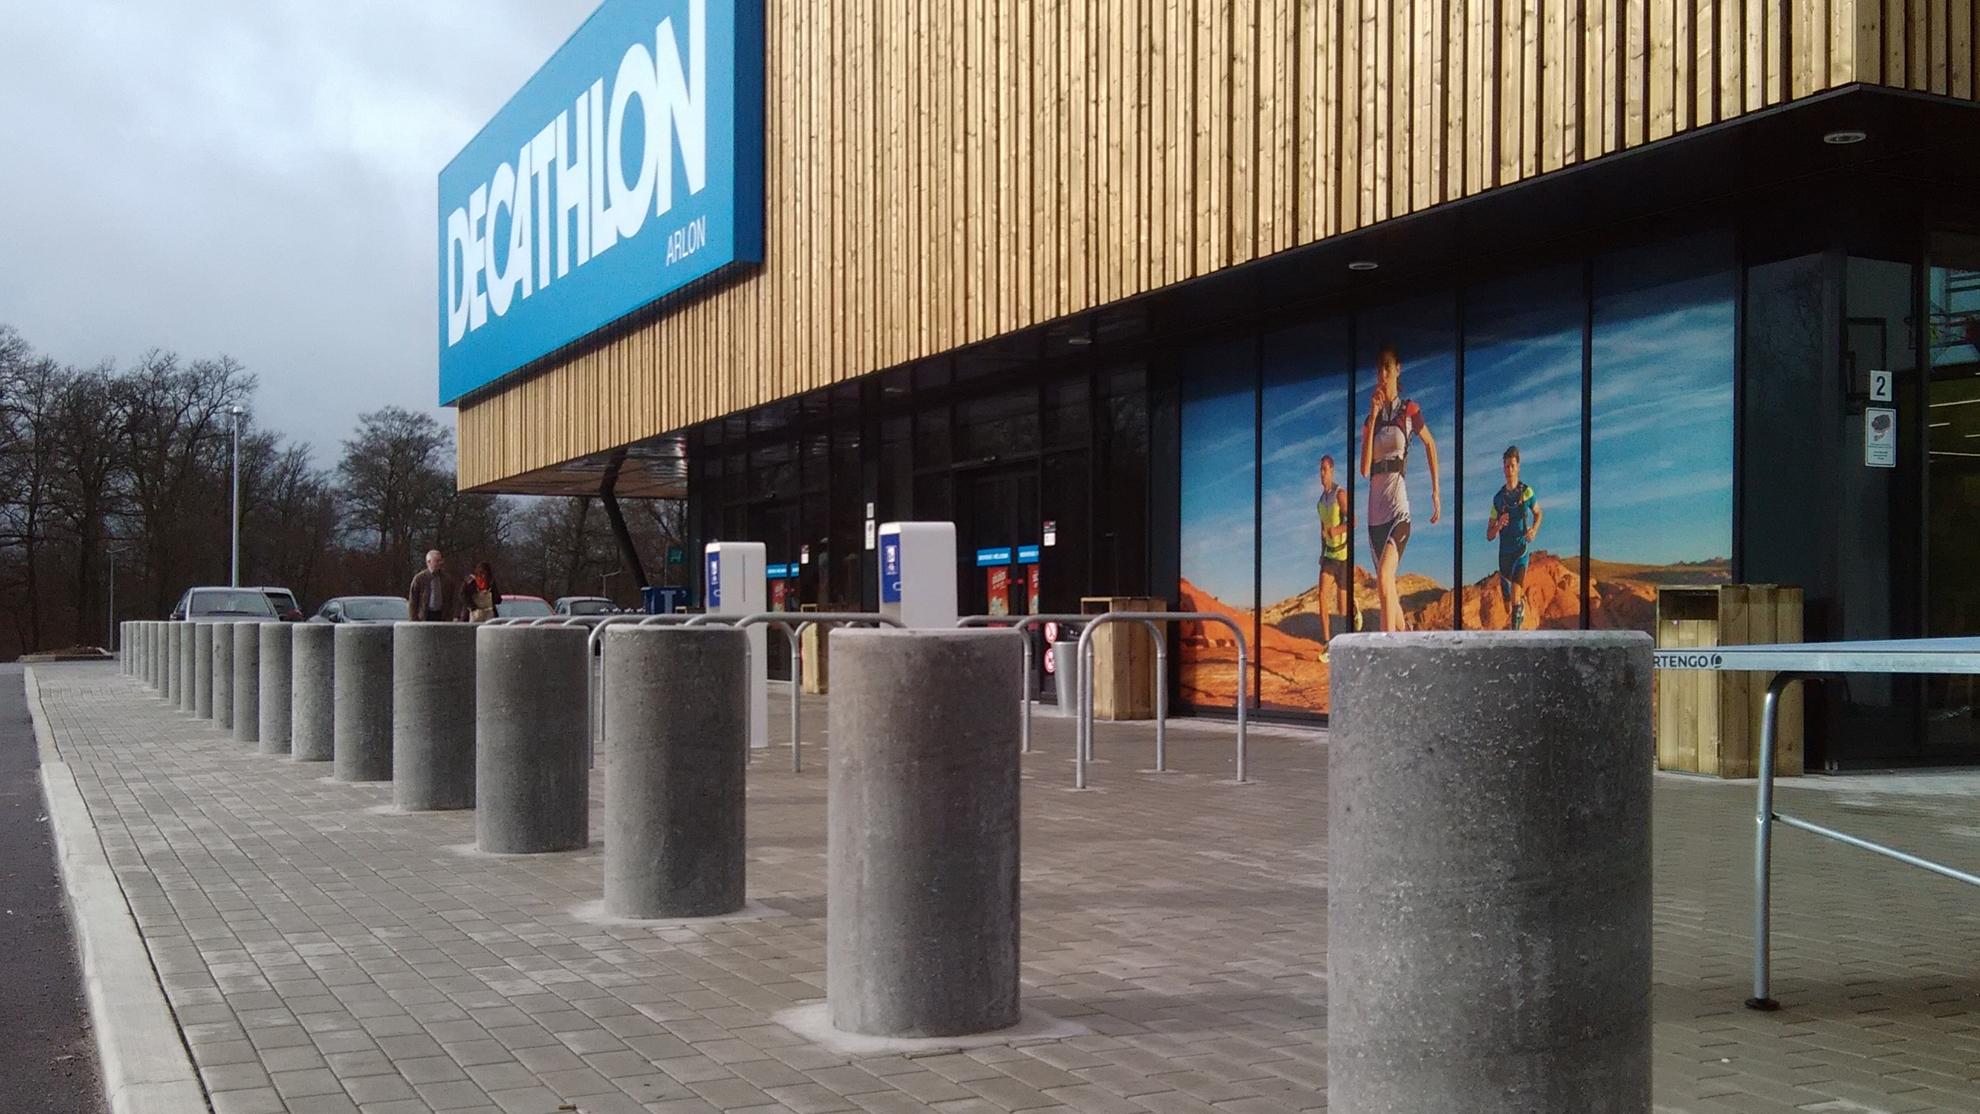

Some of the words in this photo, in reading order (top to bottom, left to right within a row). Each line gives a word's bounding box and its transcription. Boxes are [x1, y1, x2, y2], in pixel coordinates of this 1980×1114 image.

[448, 0, 706, 347] DECATHLON
[666, 215, 706, 267] ARLON
[1876, 376, 1886, 396] 2
[1653, 655, 1708, 668] RTENGO
